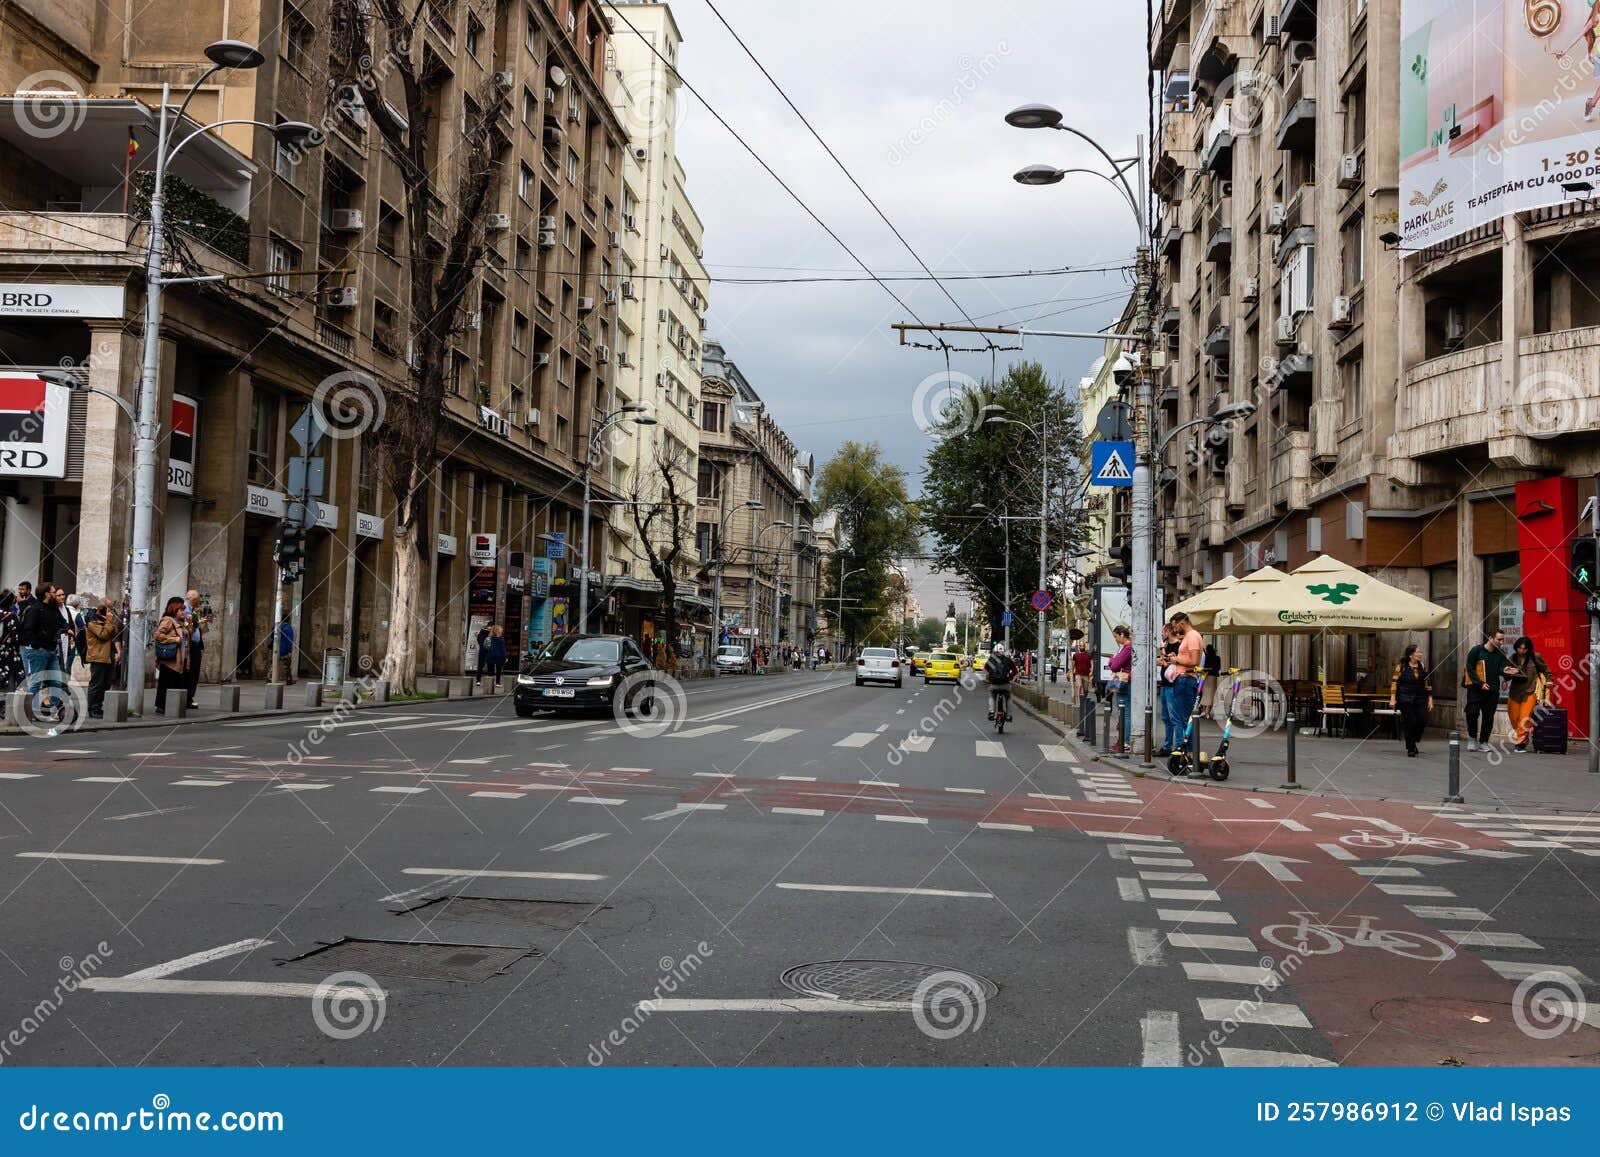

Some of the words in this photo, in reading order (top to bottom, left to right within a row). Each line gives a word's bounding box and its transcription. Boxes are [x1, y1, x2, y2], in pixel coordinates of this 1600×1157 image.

[1542, 158, 1549, 171] 1
[1566, 150, 1589, 167] 30
[1468, 198, 1477, 209] TE
[1527, 176, 1544, 188] CU
[1547, 169, 1582, 184] 4000
[1430, 216, 1455, 232] Nature
[2, 293, 53, 307] BRD
[0, 450, 48, 469] RD
[250, 493, 269, 507] BRD
[360, 519, 373, 531] BRD
[438, 538, 449, 549] BRD
[1277, 610, 1317, 624] Carlsberg
